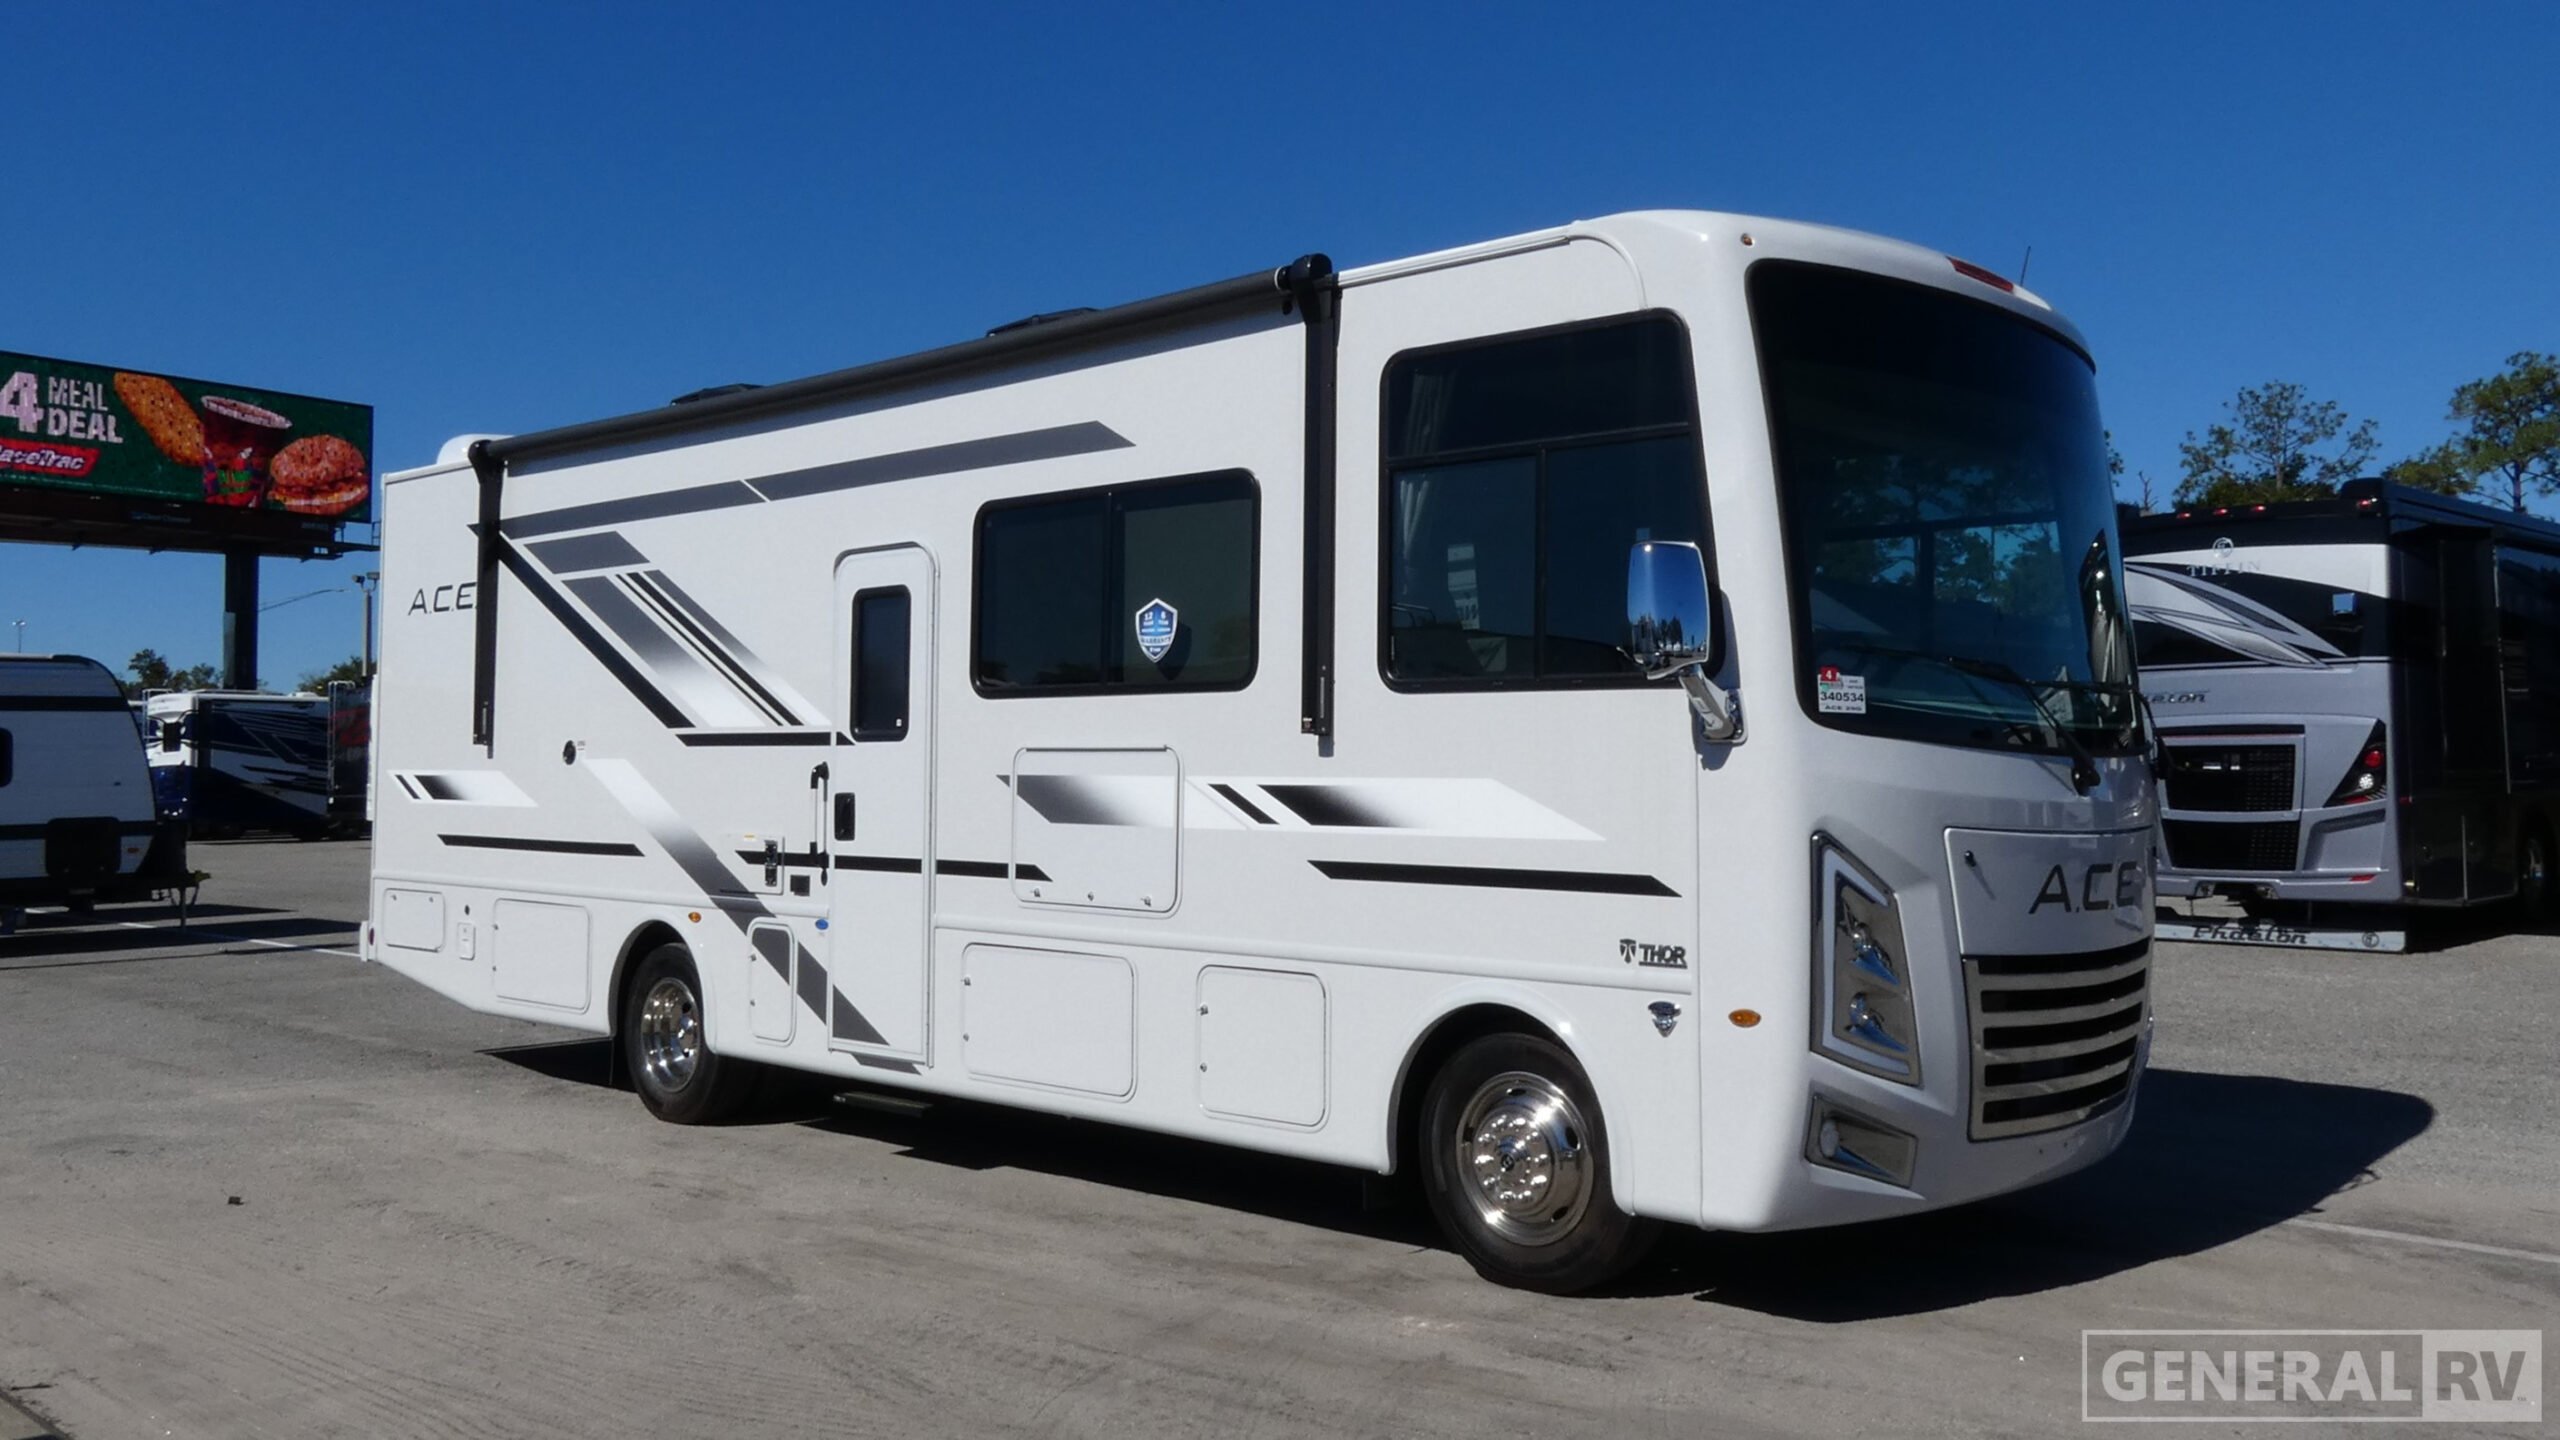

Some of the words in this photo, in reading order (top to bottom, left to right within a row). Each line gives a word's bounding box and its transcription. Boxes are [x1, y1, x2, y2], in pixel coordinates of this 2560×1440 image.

[48, 376, 109, 412] MEAL
[47, 408, 124, 444] DEAL
[0, 446, 85, 470] aceTrac
[1826, 670, 1832, 680] 4
[1820, 691, 1864, 702] 340534
[1638, 943, 1687, 967] THOR
